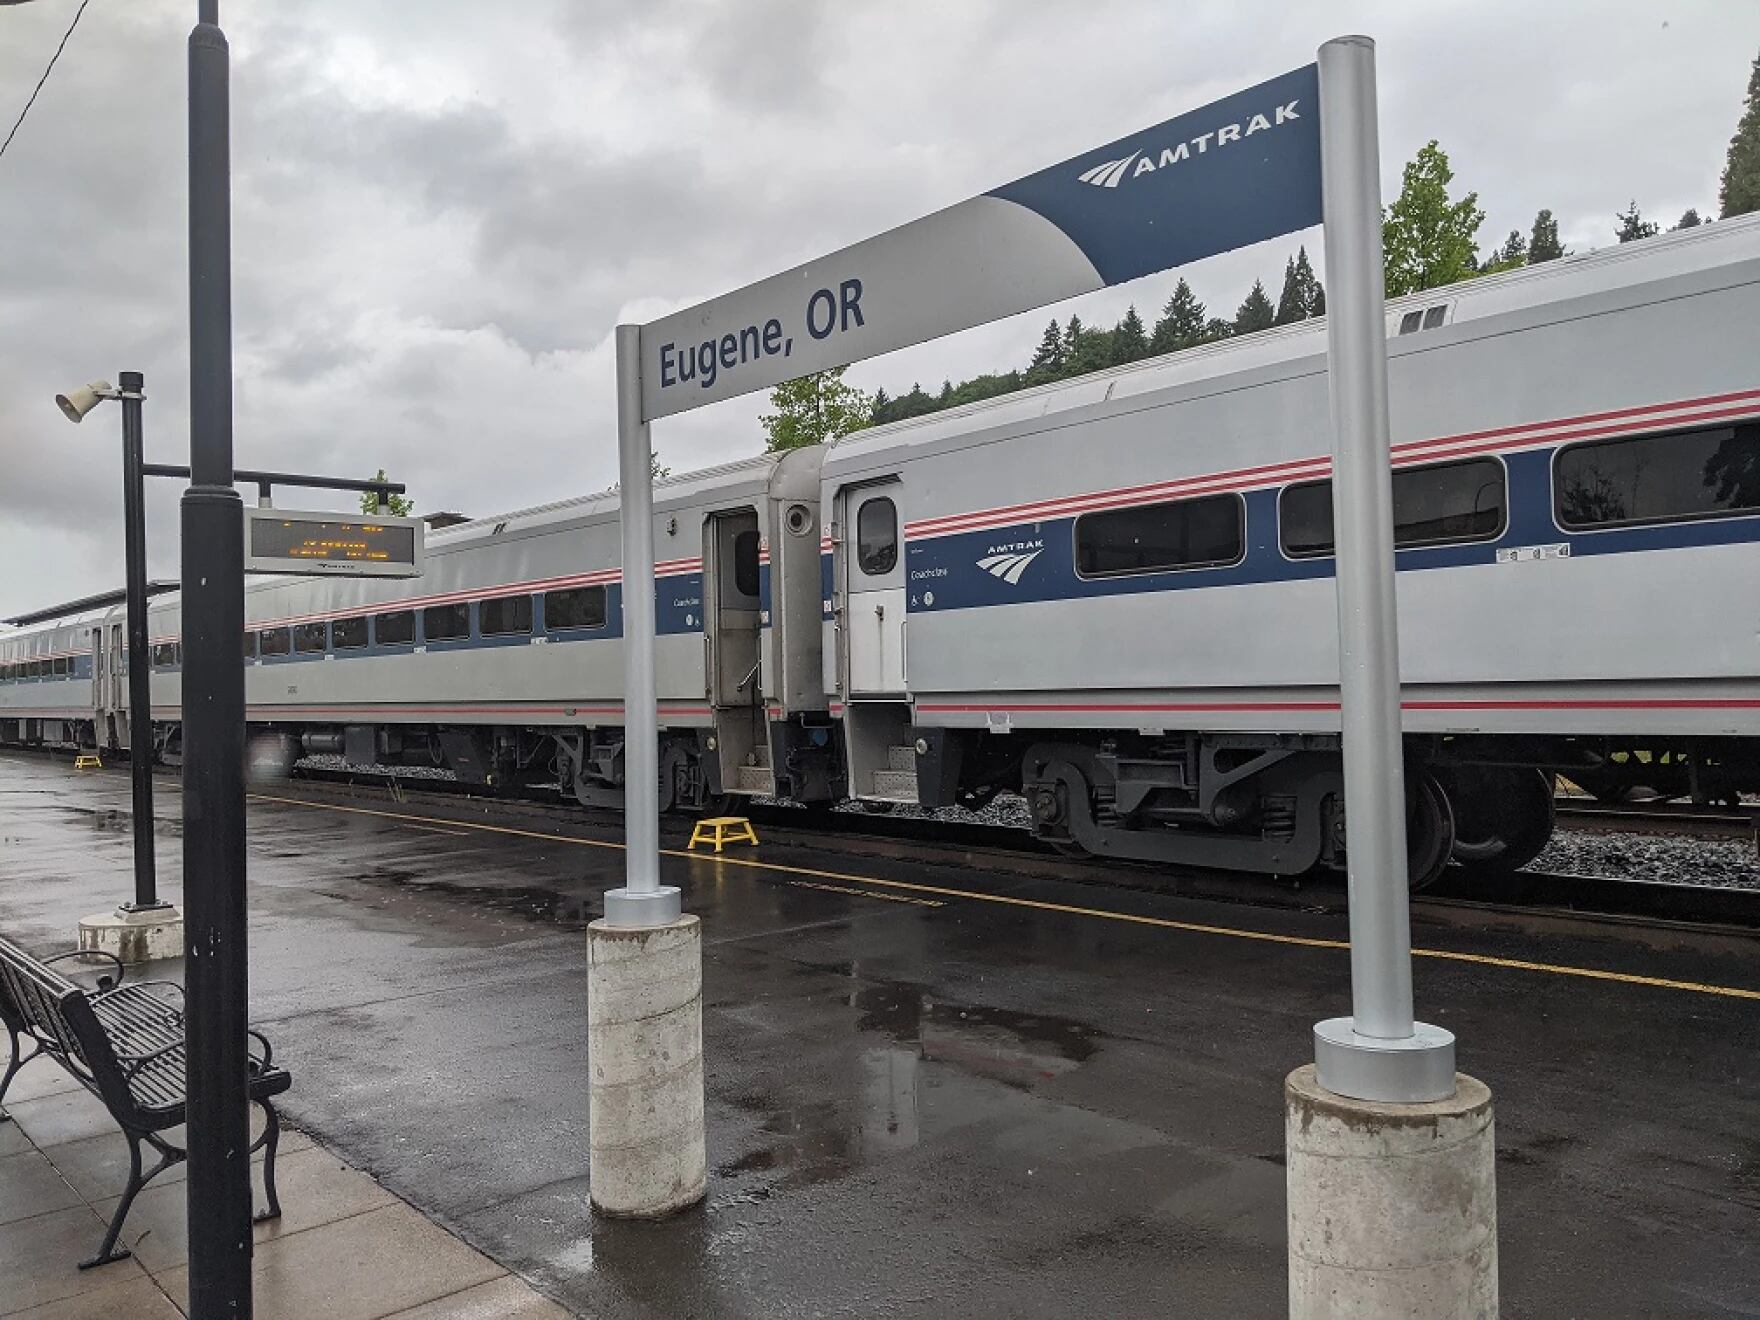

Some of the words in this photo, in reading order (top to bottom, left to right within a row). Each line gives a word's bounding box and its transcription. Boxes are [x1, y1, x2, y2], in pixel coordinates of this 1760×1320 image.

[1133, 99, 1301, 178] AMTRAK
[660, 320, 792, 388] Eugene,
[807, 279, 864, 339] OR
[988, 539, 1044, 553] AMTRAK
